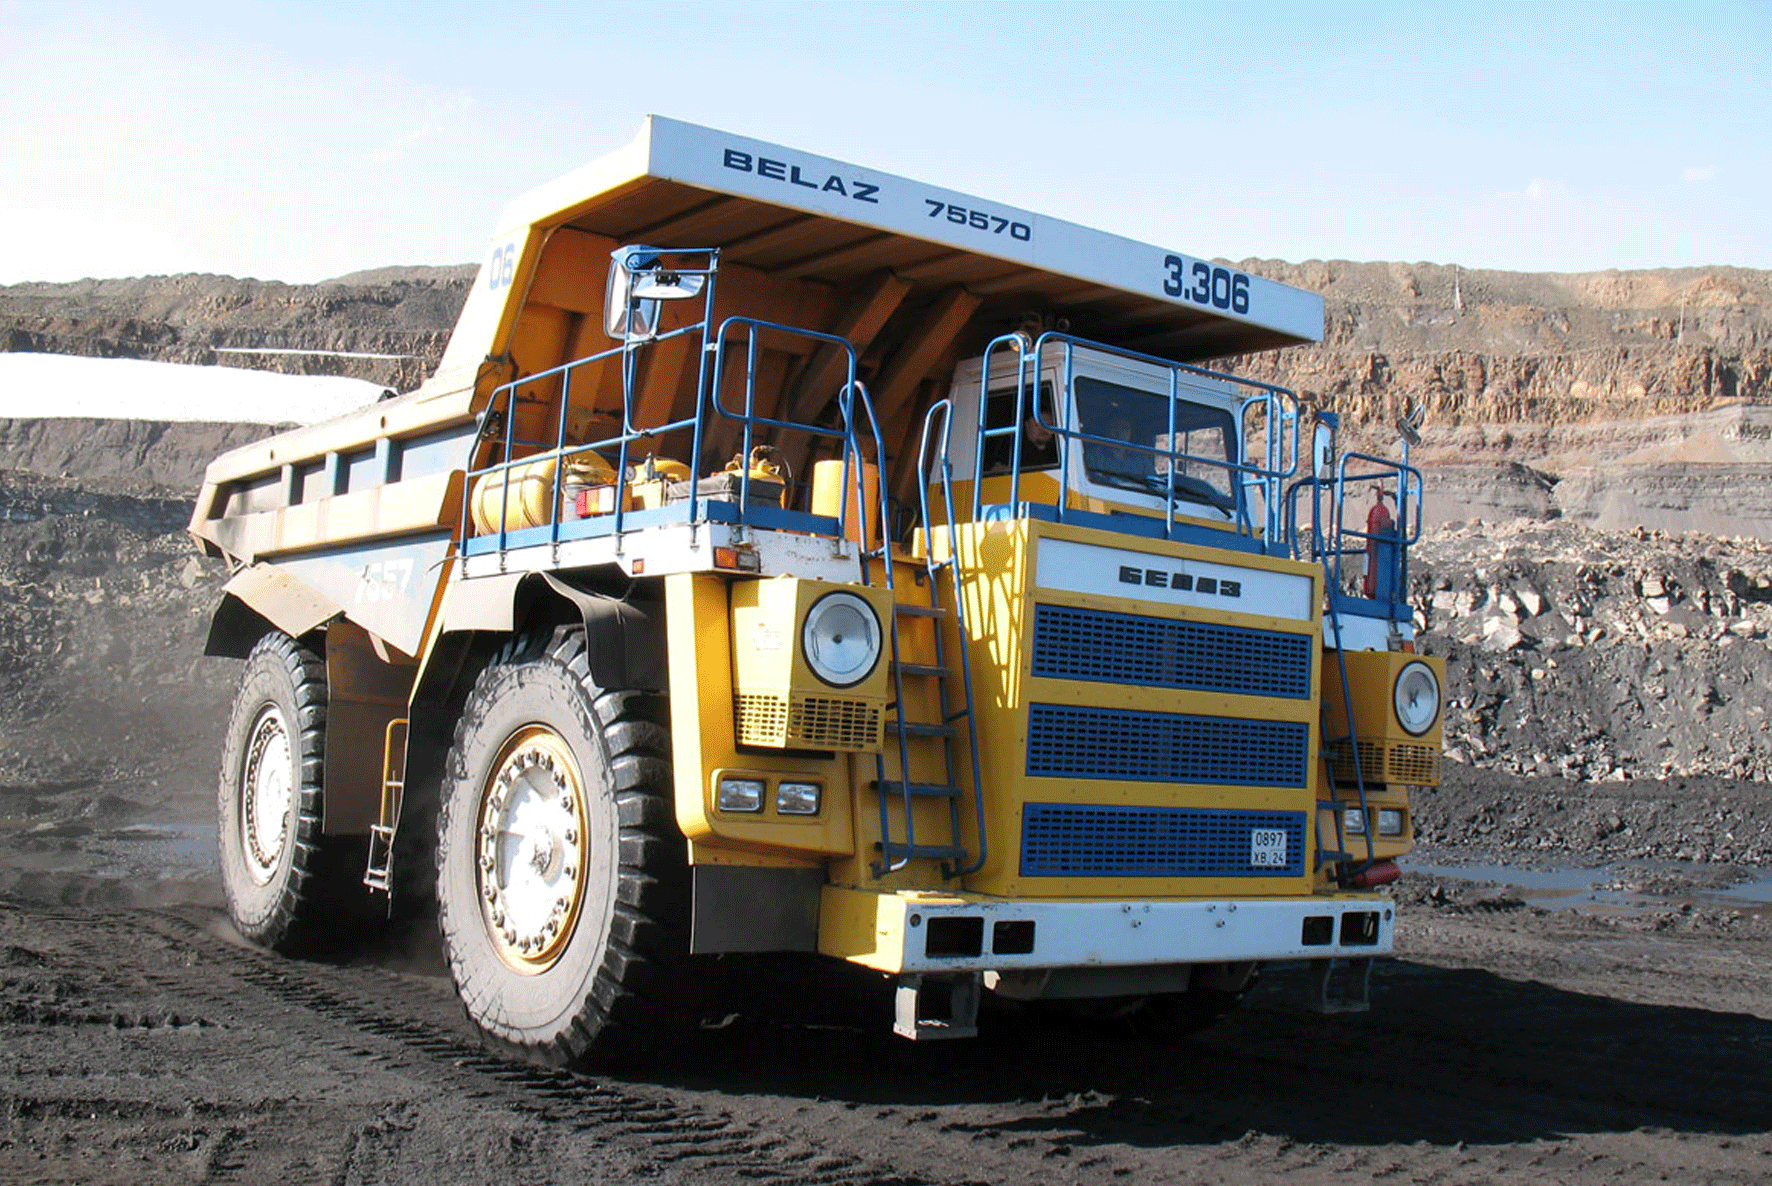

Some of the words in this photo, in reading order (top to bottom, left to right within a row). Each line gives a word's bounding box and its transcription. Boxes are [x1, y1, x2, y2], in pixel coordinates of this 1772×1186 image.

[723, 148, 880, 203] BELAZ
[925, 199, 1031, 242] 75570
[489, 242, 516, 291] 06
[1163, 254, 1250, 315] 3.306
[1255, 832, 1283, 847] 0897
[1272, 852, 1284, 864] 24
